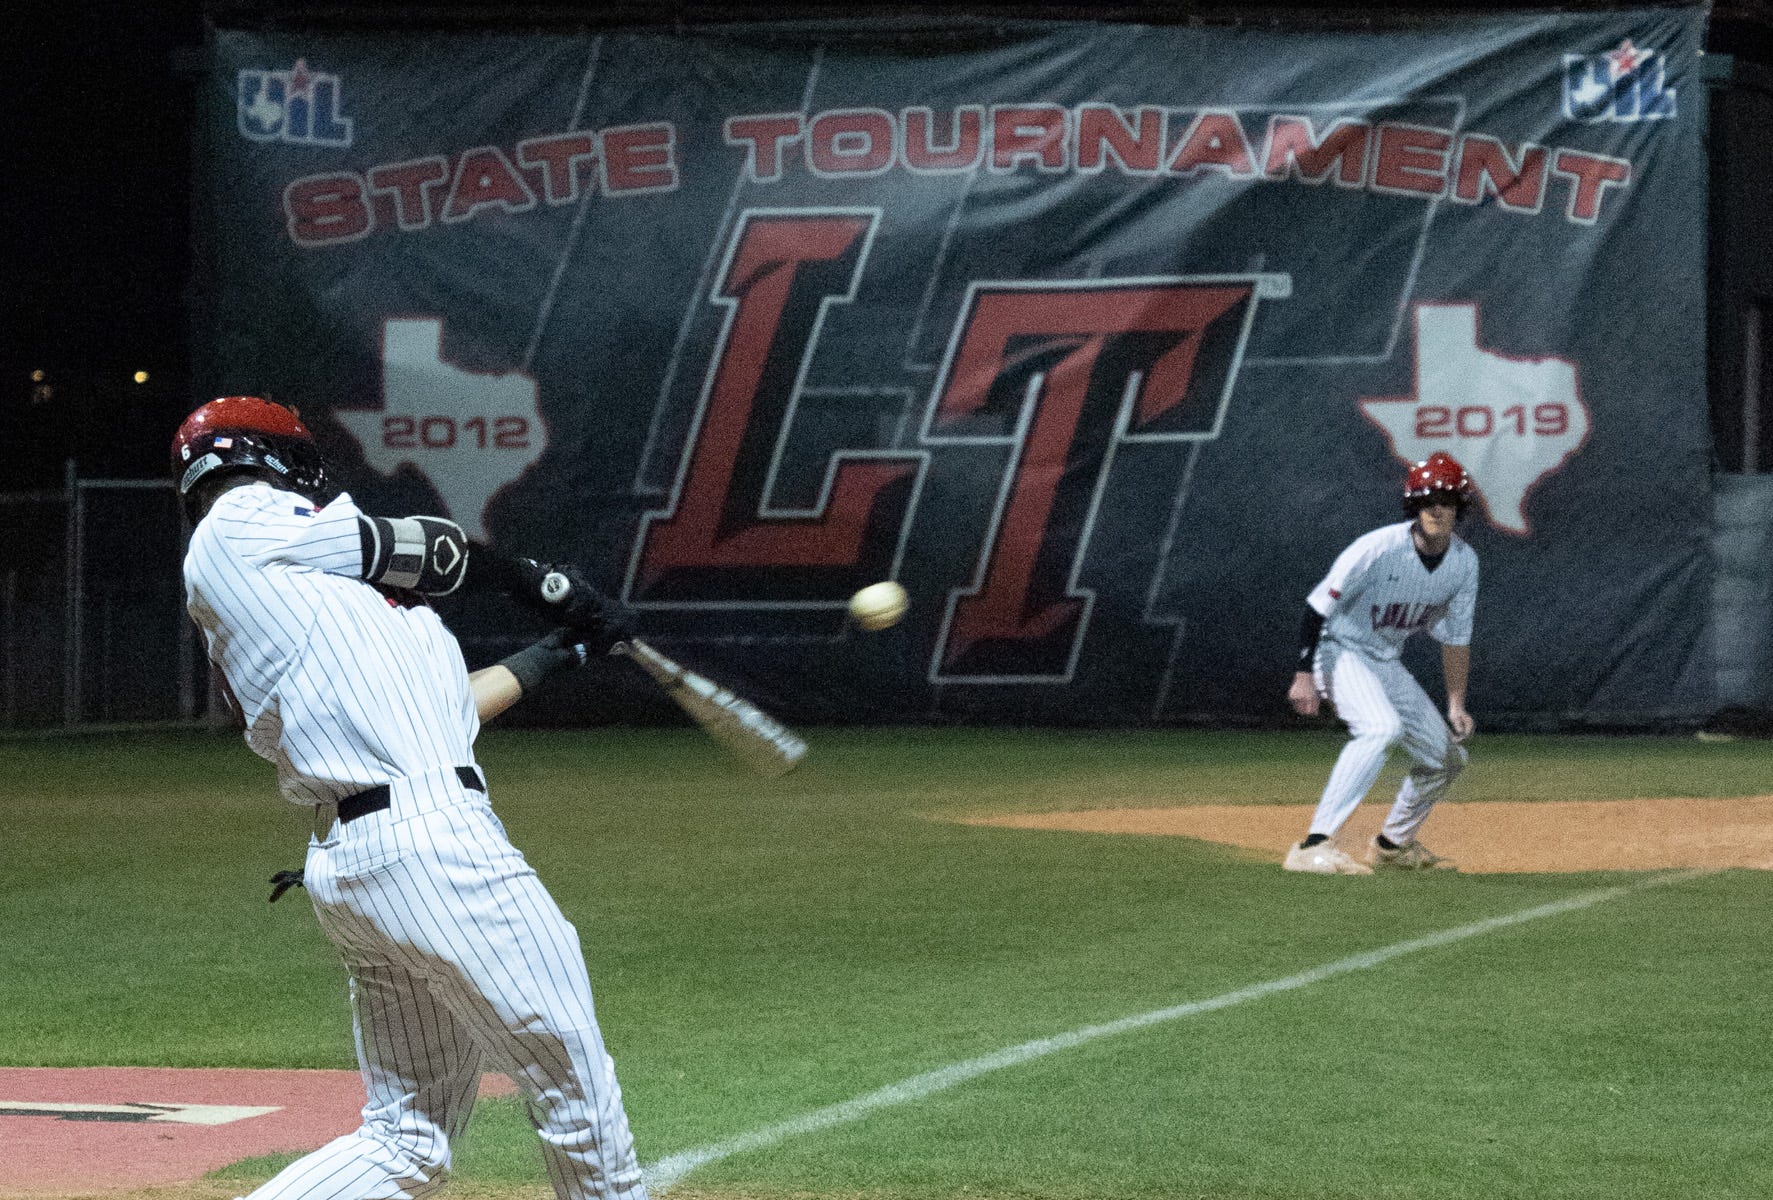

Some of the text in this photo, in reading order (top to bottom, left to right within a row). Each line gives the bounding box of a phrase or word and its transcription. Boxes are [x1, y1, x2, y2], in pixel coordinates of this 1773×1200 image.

[283, 102, 1631, 247] STATE TOURNAMENT
[383, 415, 528, 449] 2012
[1415, 403, 1569, 438] 2019
[181, 443, 191, 461] 6
[622, 205, 1264, 684] LT
